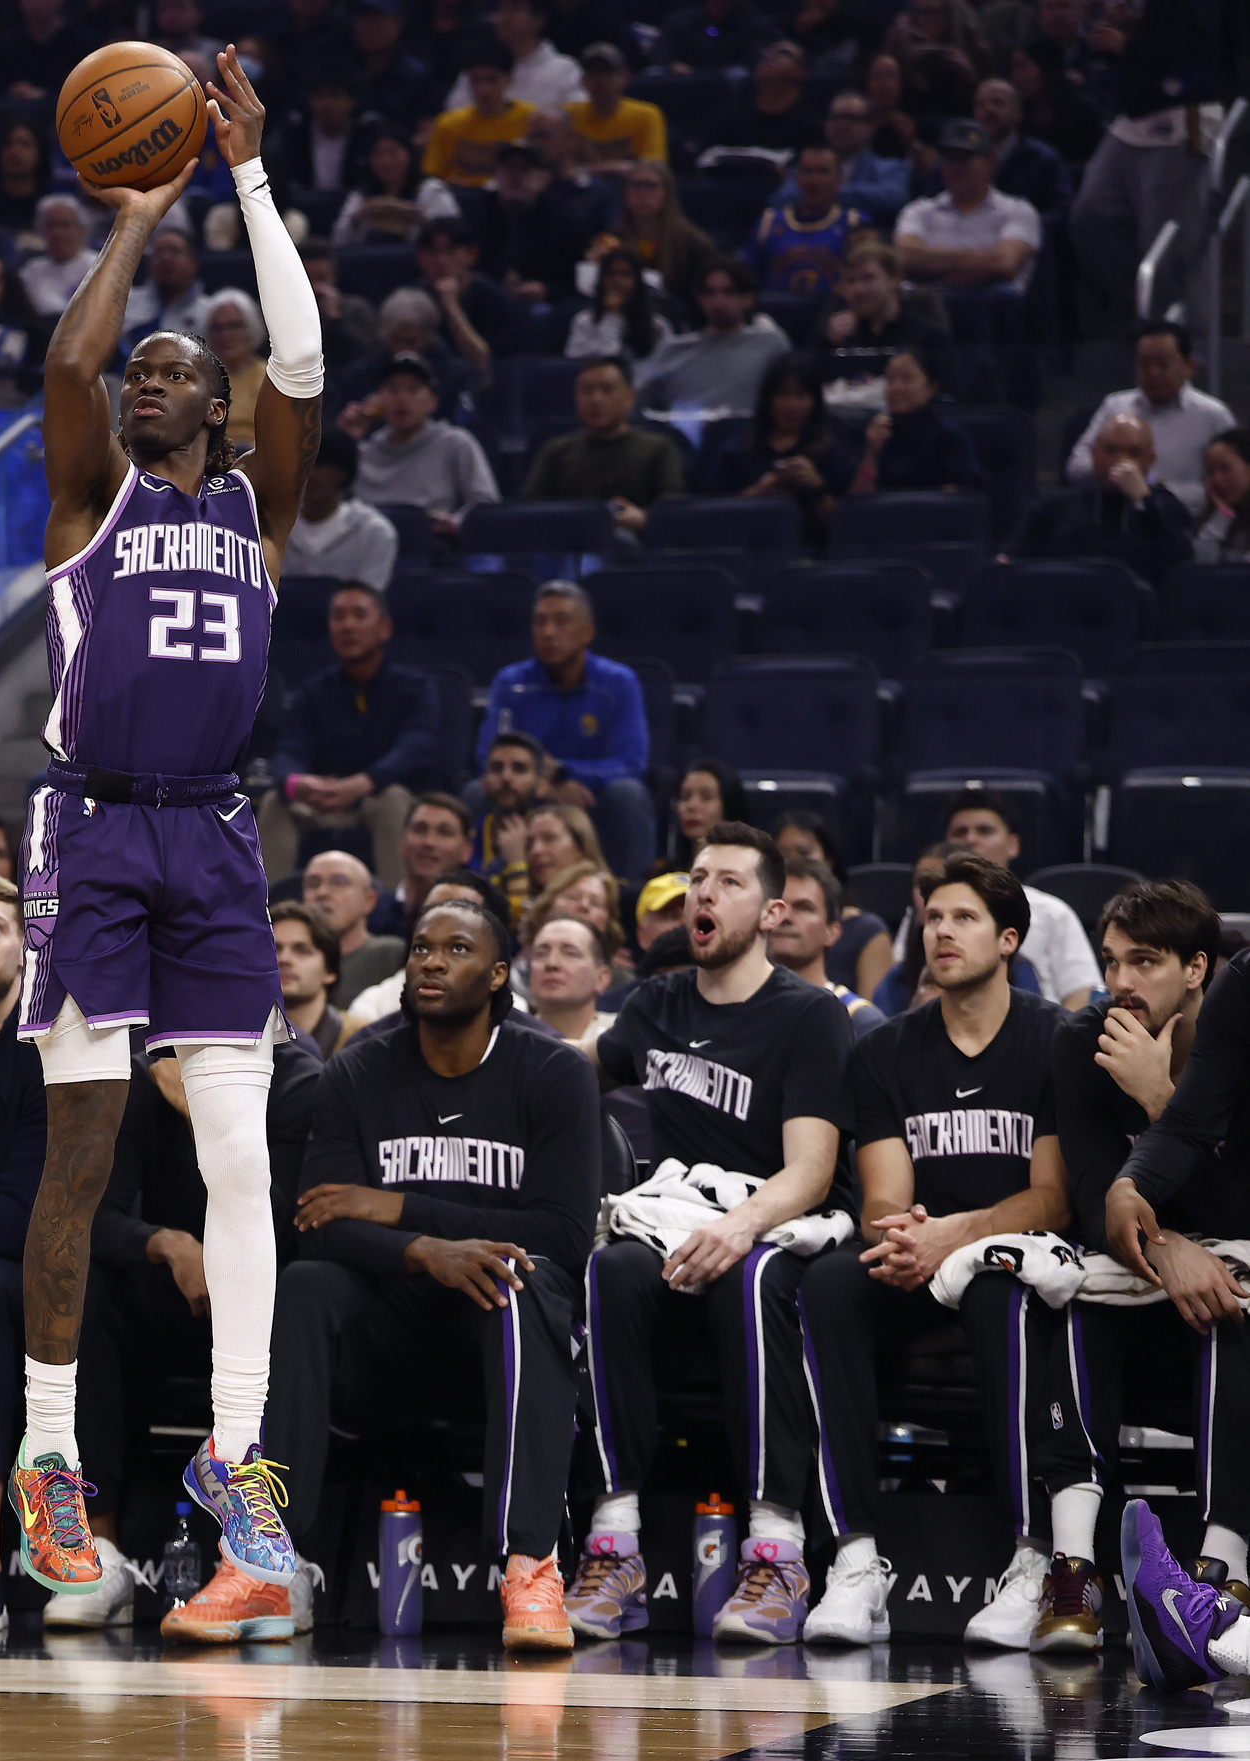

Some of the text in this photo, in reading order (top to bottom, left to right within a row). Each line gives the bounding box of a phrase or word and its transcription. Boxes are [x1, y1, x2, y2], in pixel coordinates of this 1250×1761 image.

[89, 118, 183, 176] Wilson
[113, 520, 262, 590] SACRAMENTO
[148, 587, 242, 664] 23
[23, 899, 59, 918] KINGS
[378, 1136, 525, 1190] SACRAMENTO
[905, 1109, 1034, 1162] SACRAMENTO
